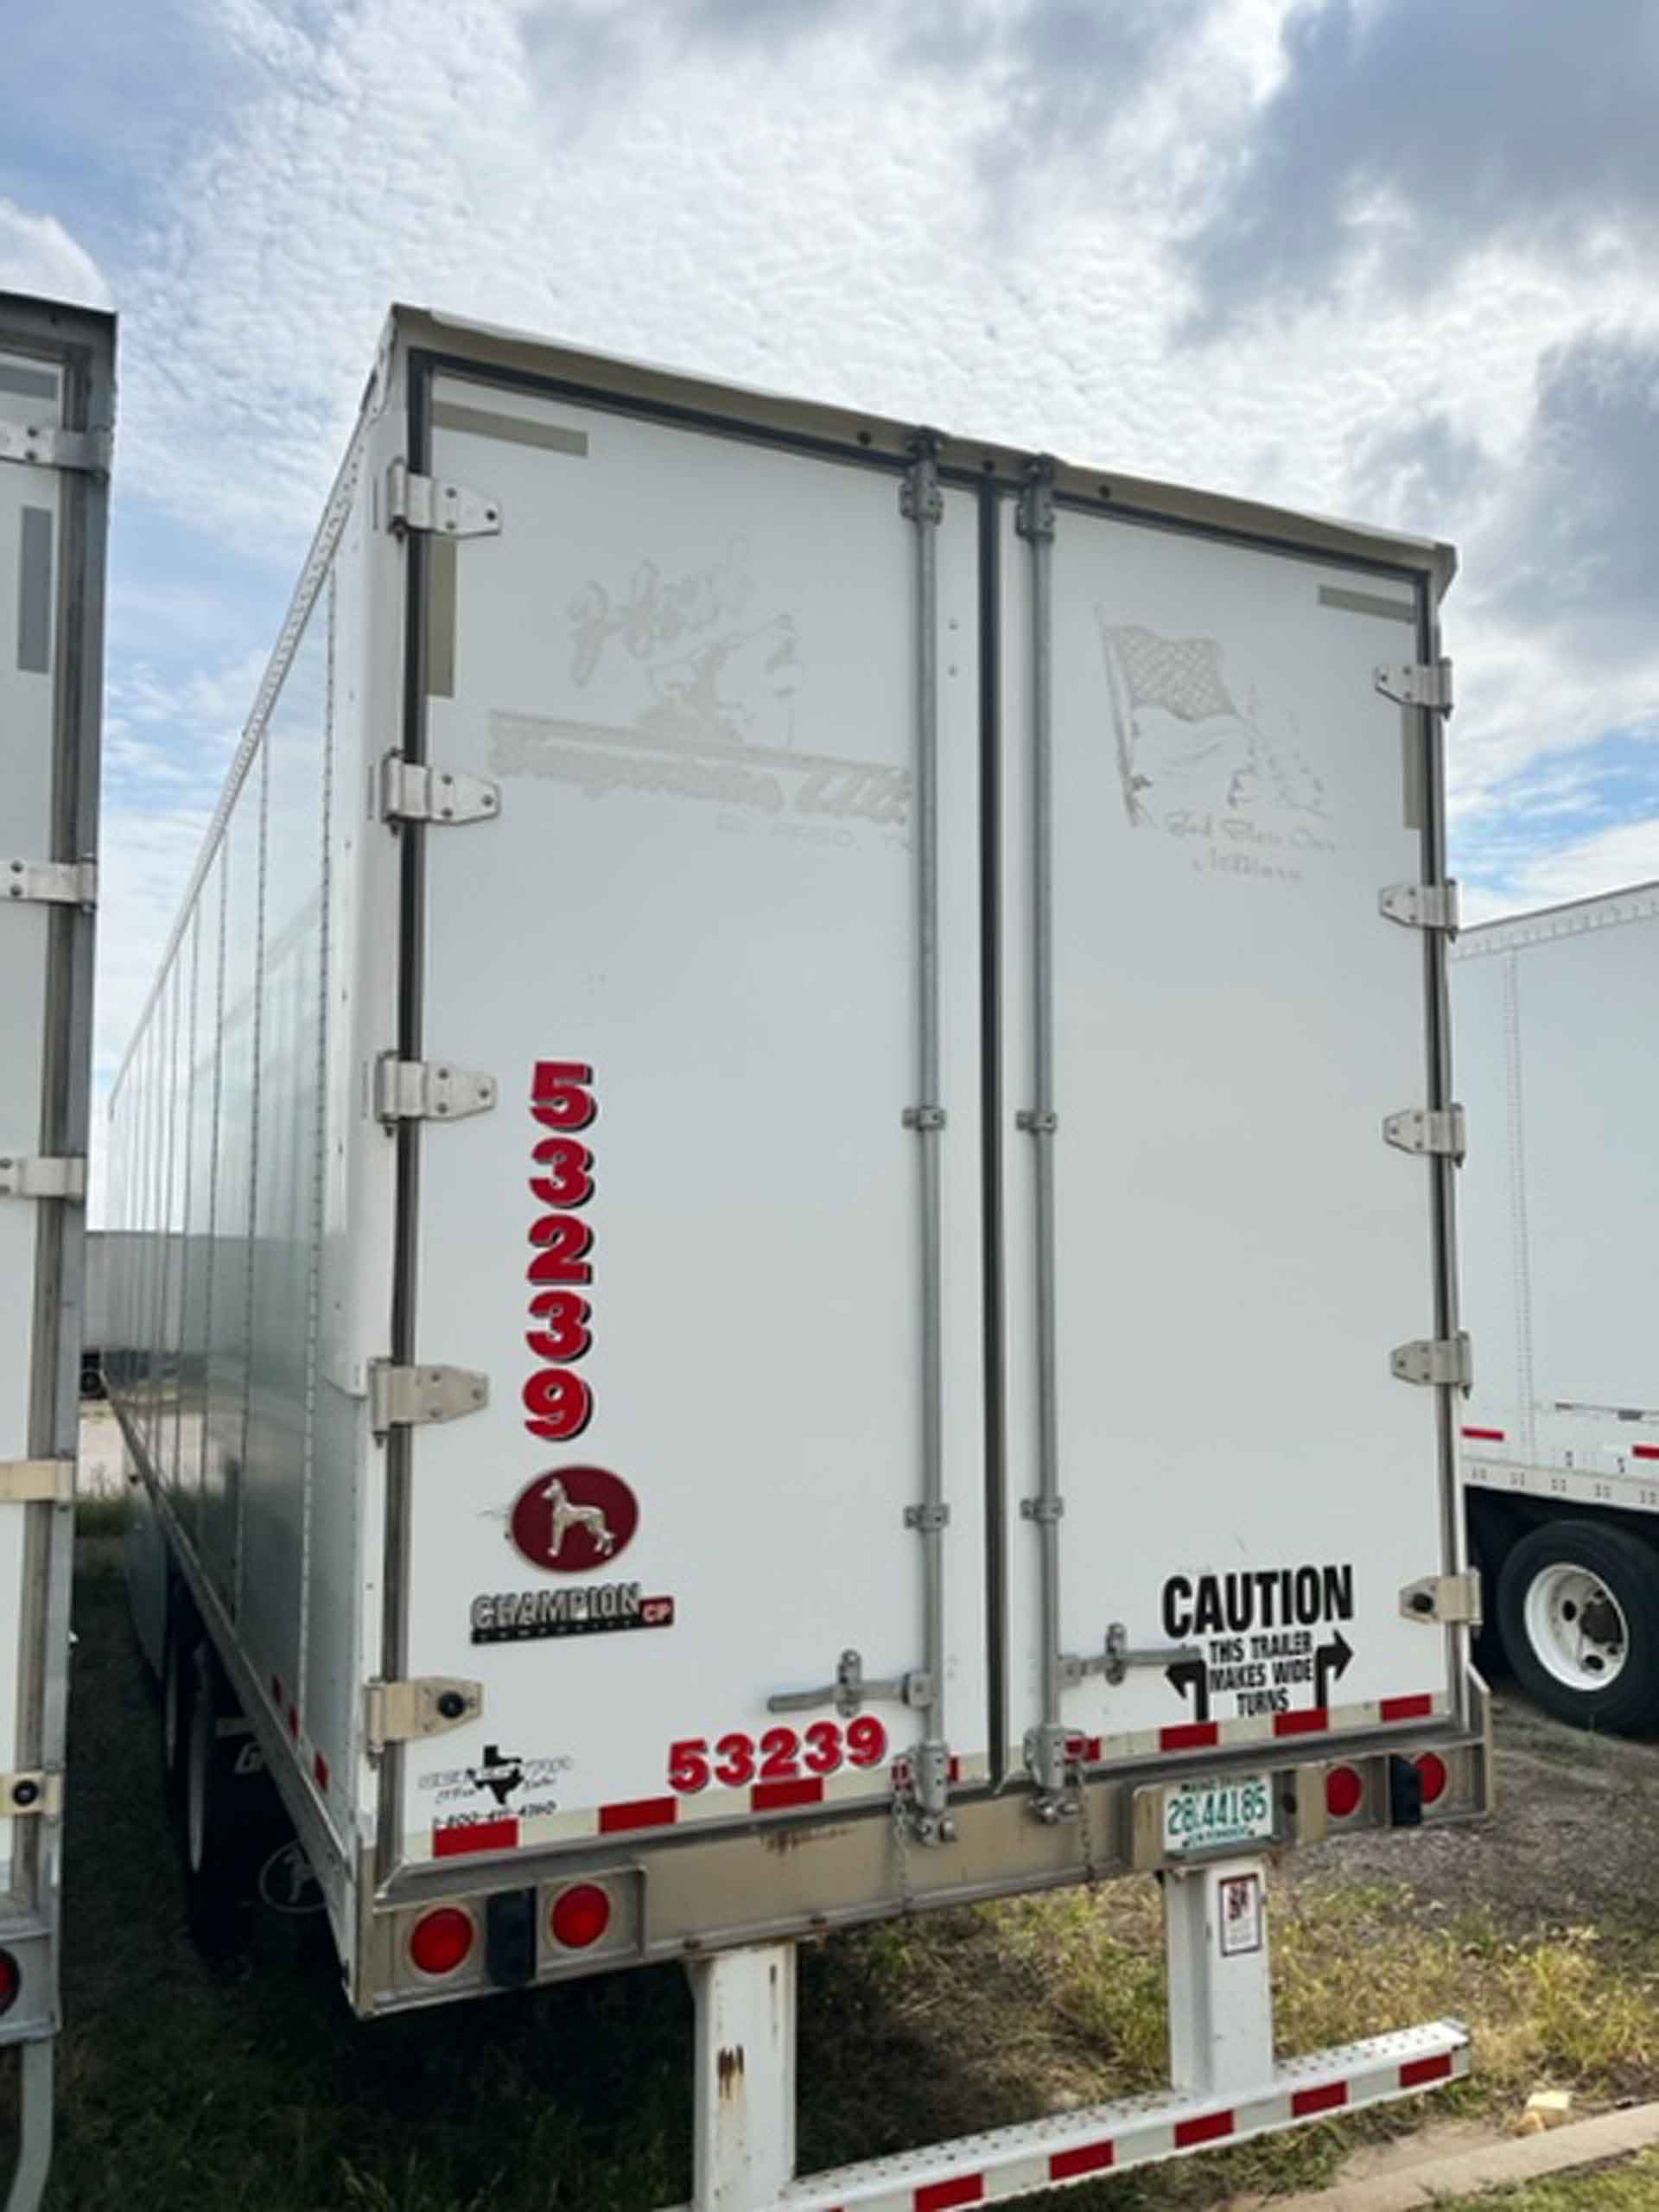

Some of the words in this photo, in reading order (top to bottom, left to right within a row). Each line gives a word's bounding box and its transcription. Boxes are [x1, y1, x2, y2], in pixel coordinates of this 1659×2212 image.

[522, 1061, 597, 1441] 53239
[472, 1582, 640, 1630] CHAMPION
[1163, 1565, 1353, 1639] CAUTION
[1209, 1637, 1244, 1664] THIS
[1250, 1631, 1312, 1659] TRAILER
[1210, 1663, 1265, 1692] MAKES
[1272, 1659, 1313, 1684] WIDE
[1236, 1688, 1289, 1716] TURNS
[668, 1714, 888, 1794] 53239
